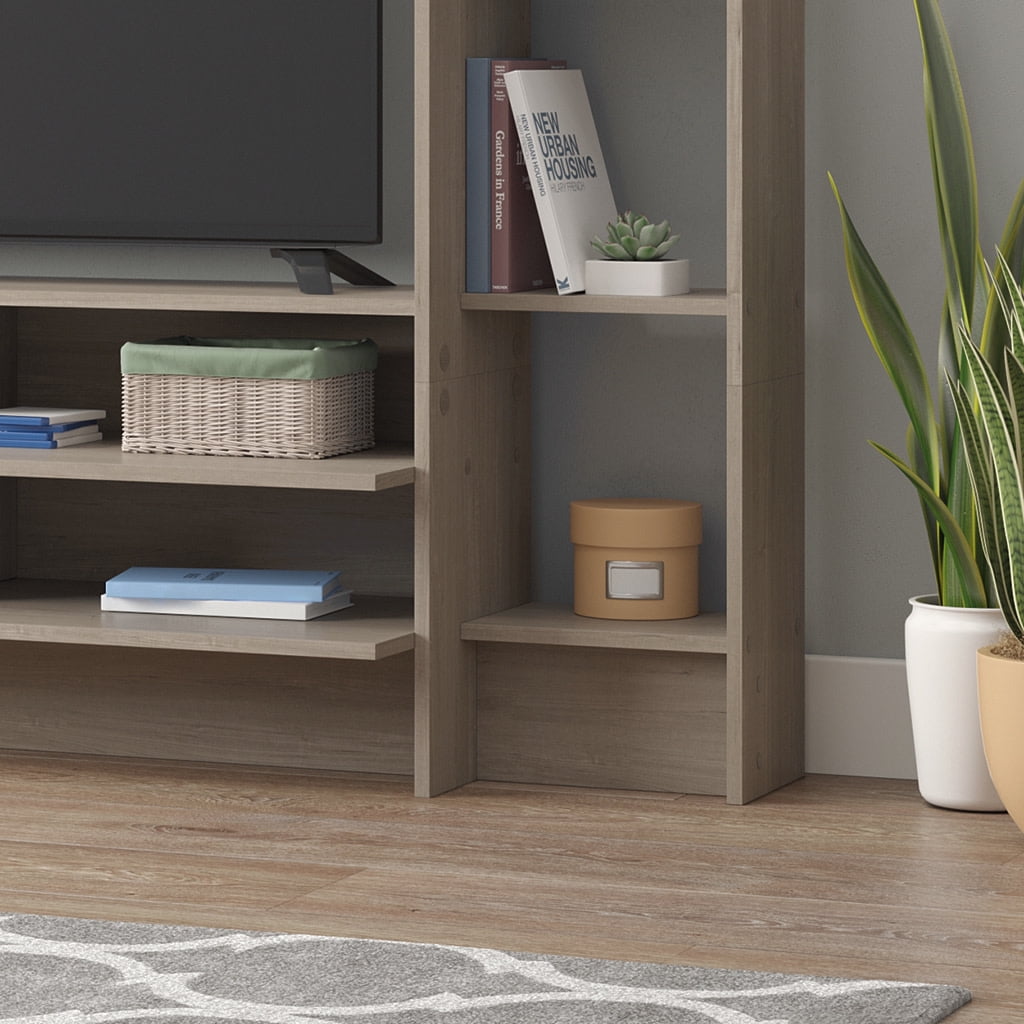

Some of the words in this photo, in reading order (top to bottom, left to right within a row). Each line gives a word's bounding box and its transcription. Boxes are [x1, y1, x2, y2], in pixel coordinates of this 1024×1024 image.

[532, 112, 560, 134] NEW
[495, 130, 505, 176] Gardens
[520, 114, 530, 132] NEW
[526, 133, 536, 160] URBAN
[532, 160, 546, 197] HOUSING
[538, 134, 580, 158] URBAN
[544, 156, 597, 181] HOUSING
[495, 179, 505, 189] in
[495, 192, 505, 230] France
